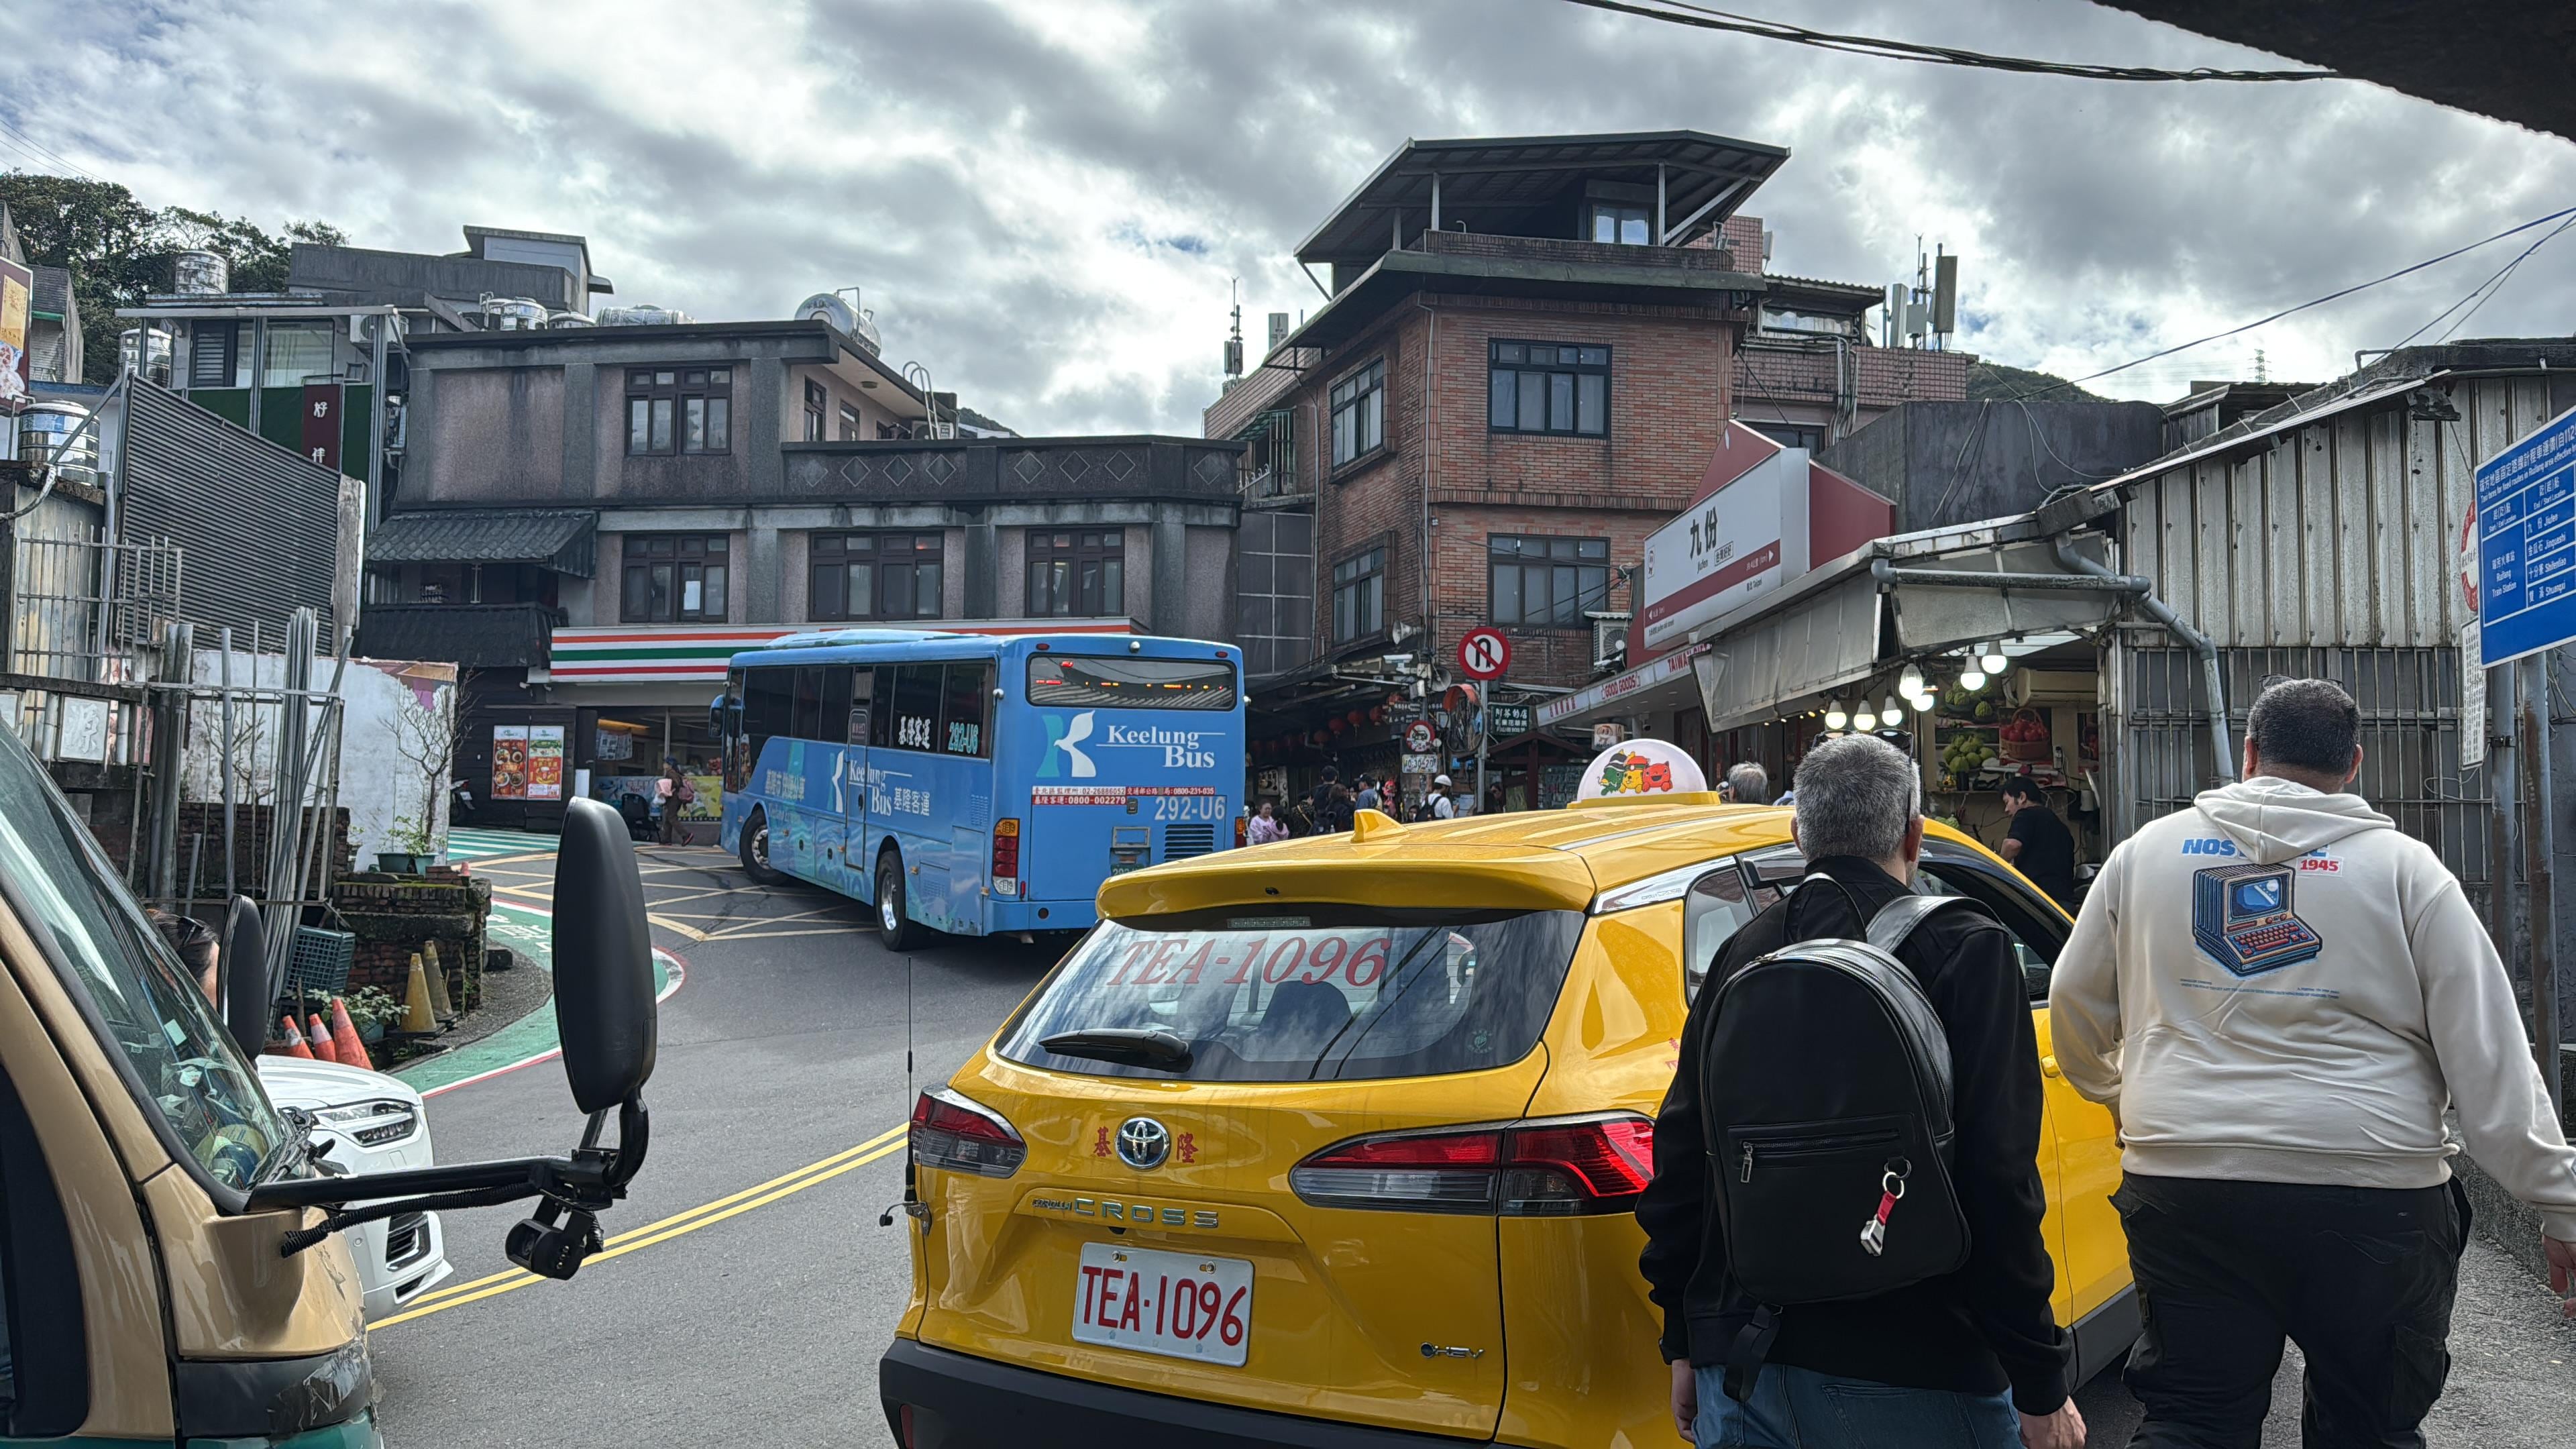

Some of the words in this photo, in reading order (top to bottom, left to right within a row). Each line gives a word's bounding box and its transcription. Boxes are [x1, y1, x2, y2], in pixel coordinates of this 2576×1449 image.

[1690, 506, 1717, 560] 九份
[1605, 682, 1618, 698] GOOD
[1619, 674, 1636, 692] GOODS
[898, 716, 931, 750] 基隆客運
[948, 721, 979, 755] 292-U6
[1108, 725, 1200, 750] Keelung
[1163, 745, 1216, 768] Bus
[850, 760, 886, 792] Keelung
[871, 787, 892, 816] Bus
[894, 787, 930, 816] 基隆客運
[1155, 796, 1226, 820] 292-U6
[2300, 859, 2339, 871] 1945
[1107, 937, 1391, 986] TEA-1096
[1094, 1126, 1112, 1157] 基
[1176, 1132, 1198, 1165] 隆
[1074, 1197, 1218, 1228] CROSS
[1082, 1266, 1246, 1346] TEA-1096
